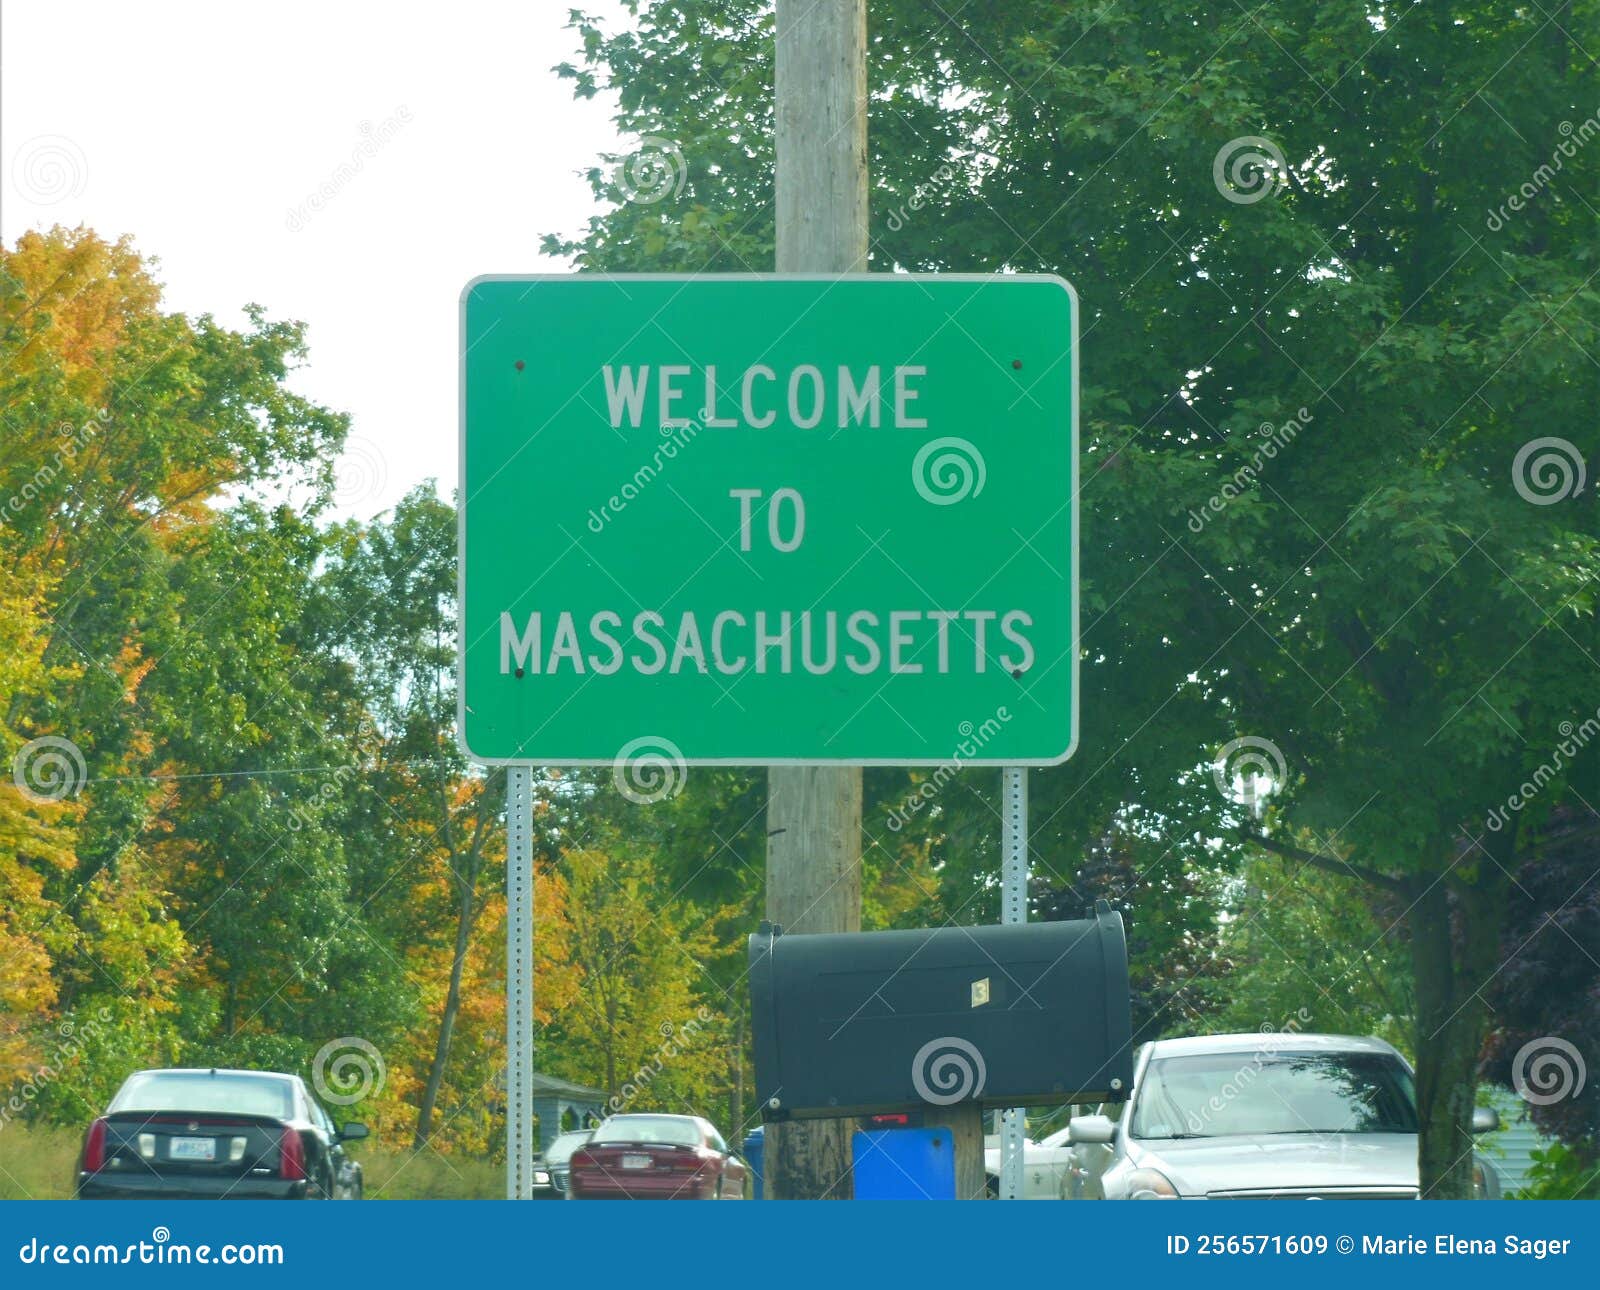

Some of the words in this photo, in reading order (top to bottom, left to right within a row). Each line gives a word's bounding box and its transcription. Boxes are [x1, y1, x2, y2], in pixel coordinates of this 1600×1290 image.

[602, 364, 929, 429] WELCOME
[729, 487, 807, 553] TO
[499, 609, 1036, 676] MASSACHUSETTS
[975, 981, 987, 1002] 3
